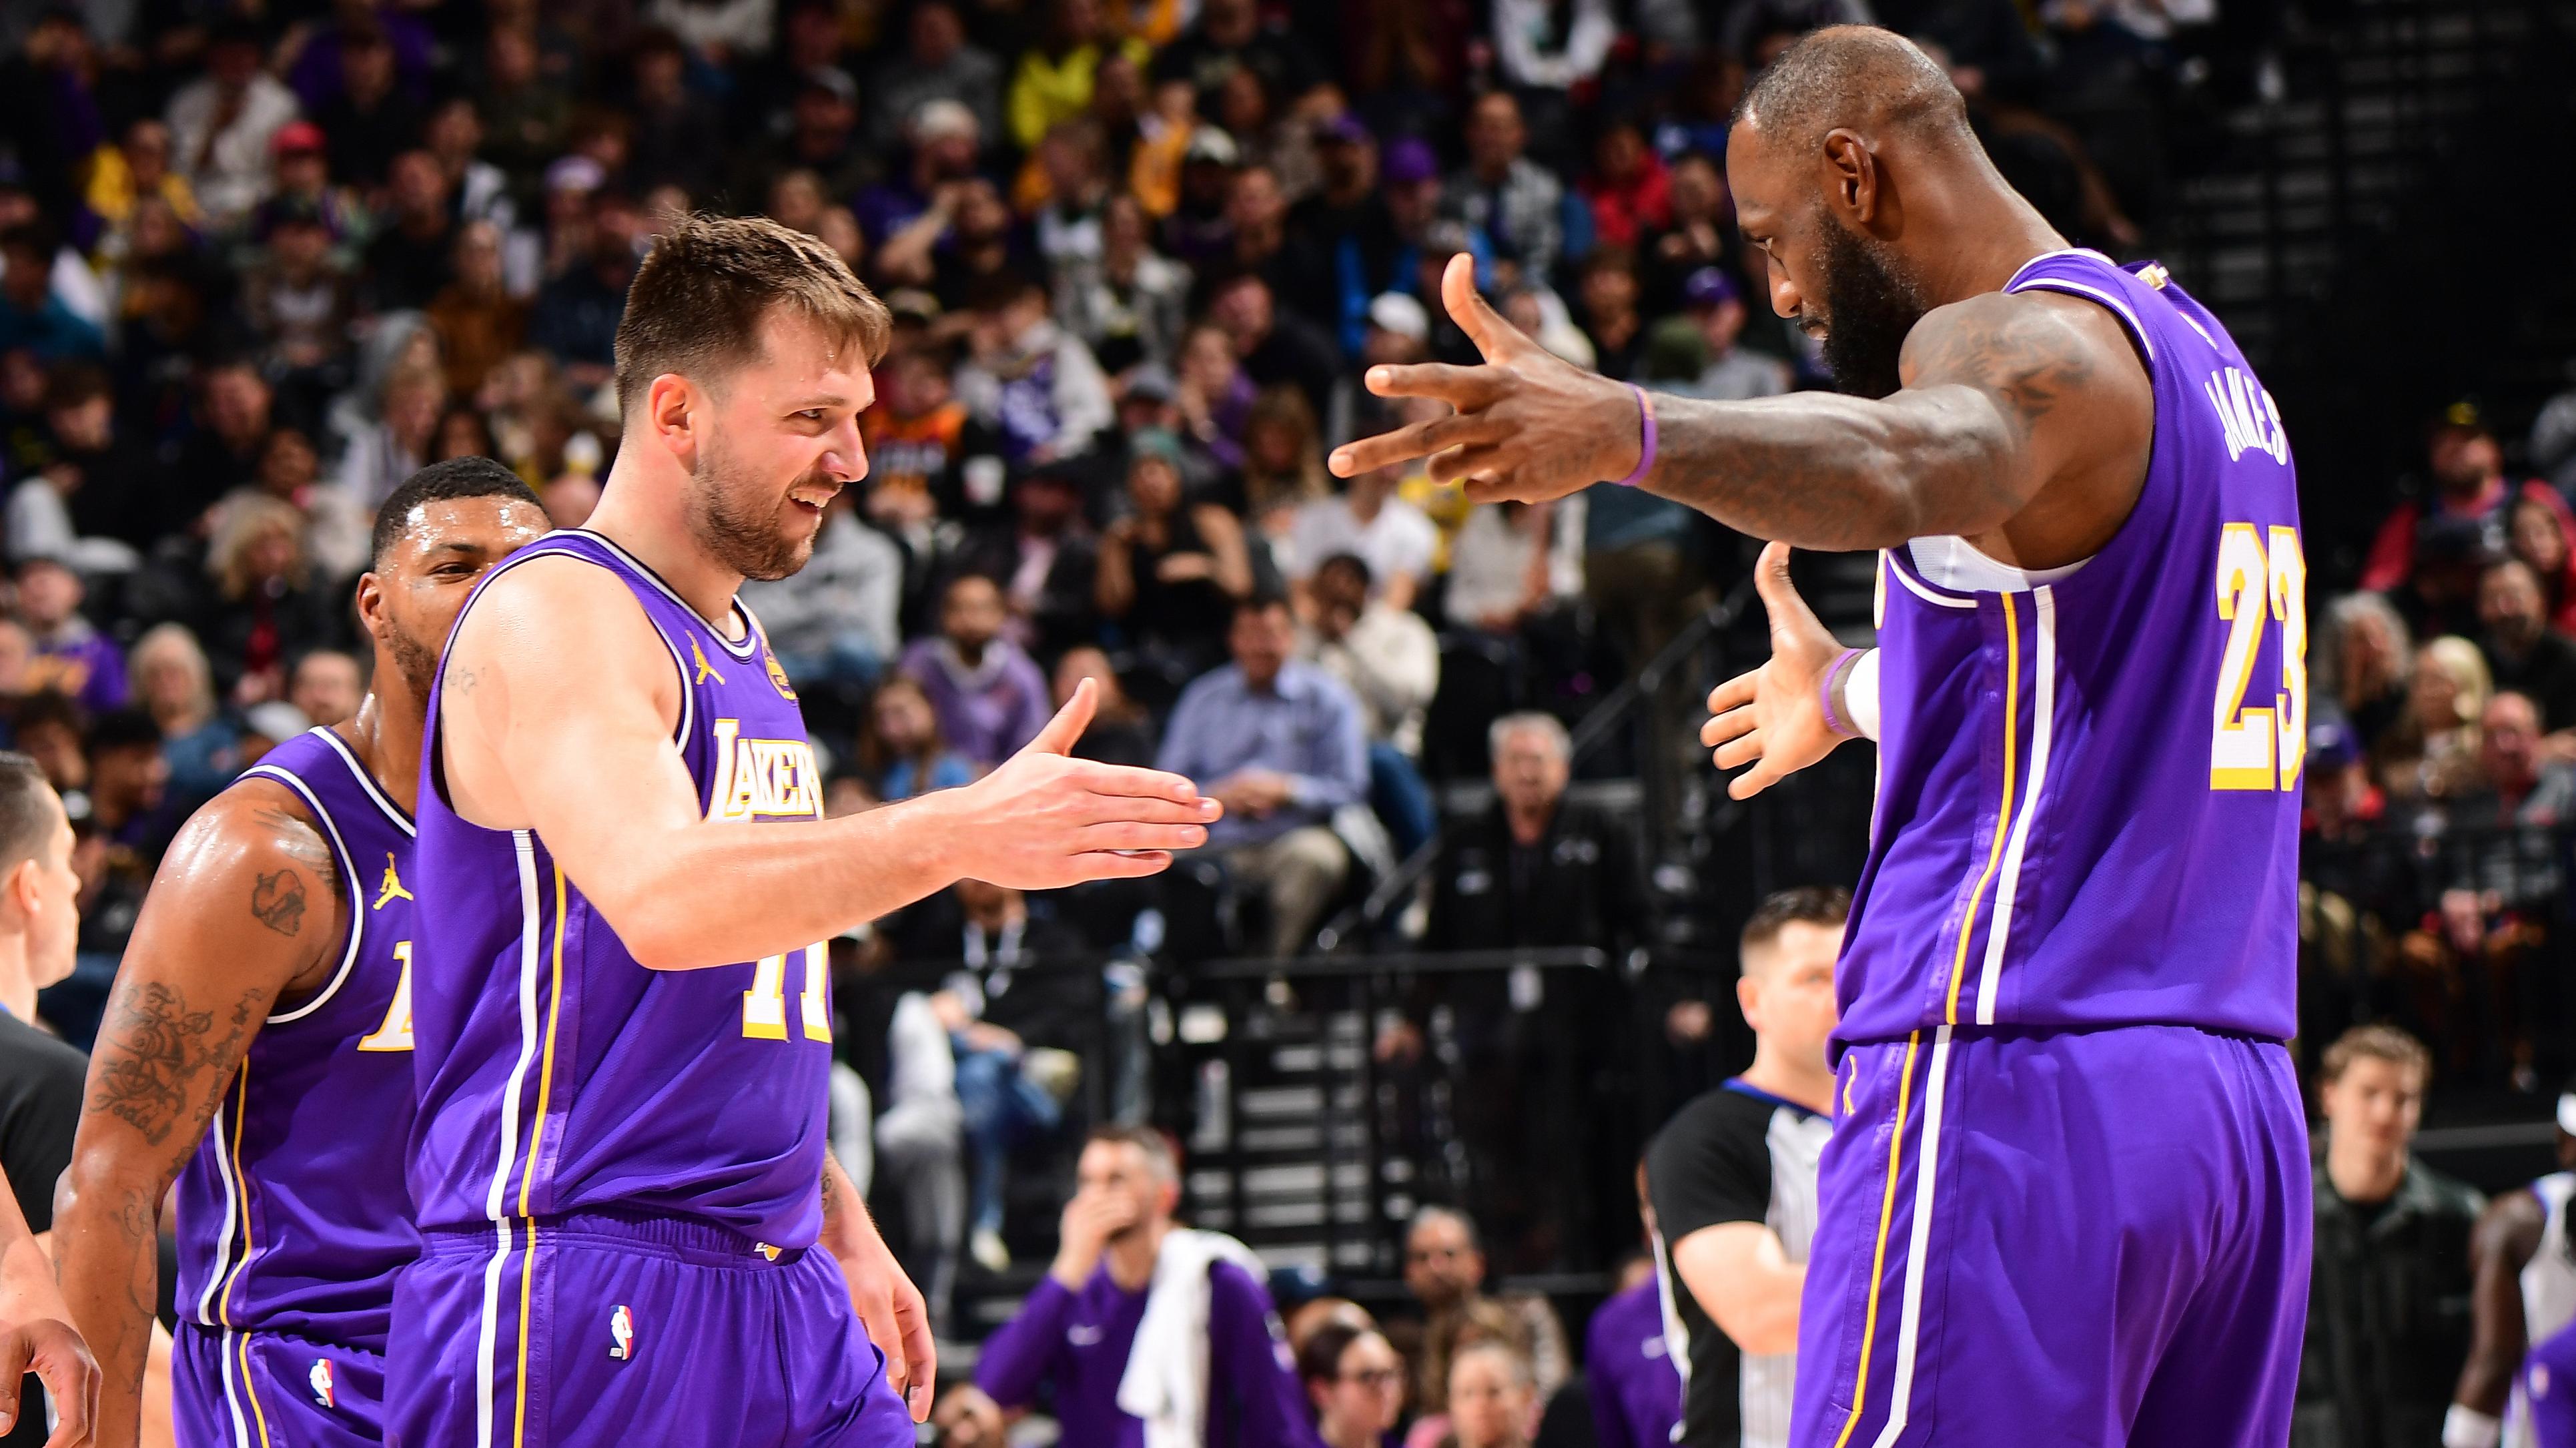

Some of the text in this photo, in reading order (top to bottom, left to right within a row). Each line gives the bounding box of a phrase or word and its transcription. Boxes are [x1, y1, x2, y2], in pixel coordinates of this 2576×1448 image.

[2204, 366, 2287, 465] JAMES
[2210, 522, 2306, 791] 23
[703, 718, 825, 823] LAKER
